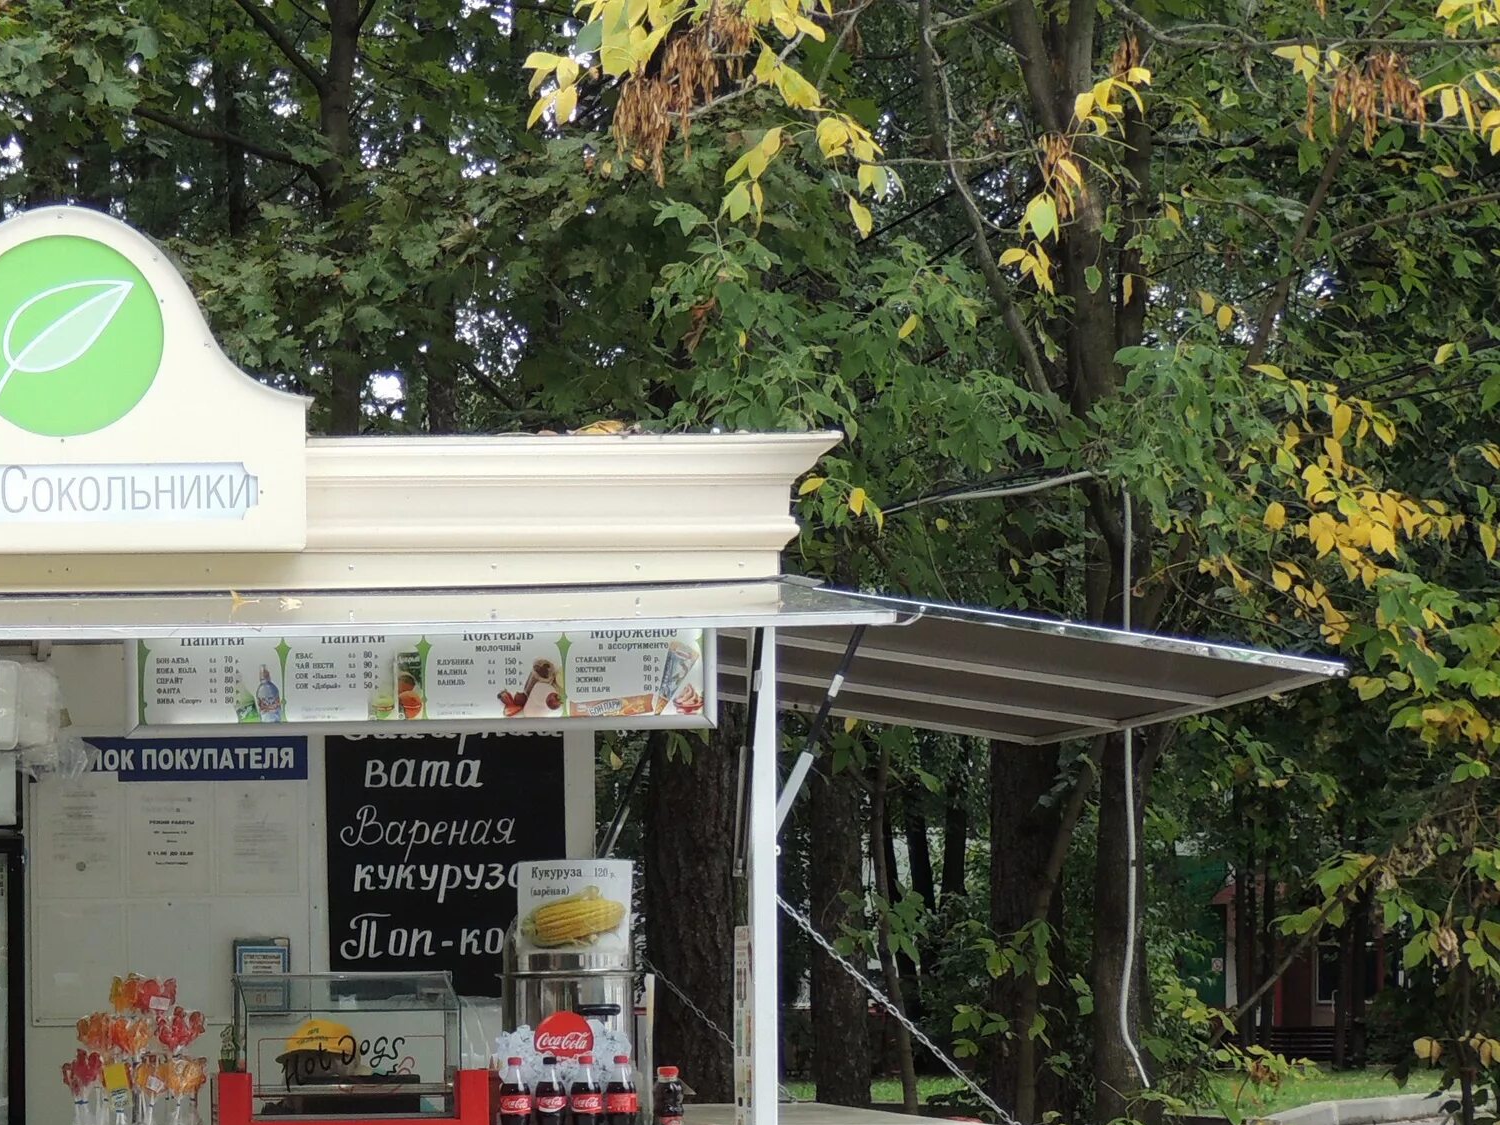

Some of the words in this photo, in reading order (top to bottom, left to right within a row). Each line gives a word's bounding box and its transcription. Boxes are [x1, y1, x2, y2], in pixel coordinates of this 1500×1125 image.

[0, 464, 251, 514] Сокольники
[590, 628, 678, 641] Мороженое
[607, 642, 669, 651] ассортименте
[363, 671, 373, 679] 90
[141, 747, 295, 771] ПОКУПАТЕЛЯ
[363, 758, 484, 788] вата
[340, 804, 516, 862] Вареная
[531, 866, 582, 879] Кукуруза
[594, 867, 608, 877] 120
[340, 912, 504, 960] Поп-ко
[281, 1042, 331, 1093] Hot
[338, 1035, 405, 1068] Dogs
